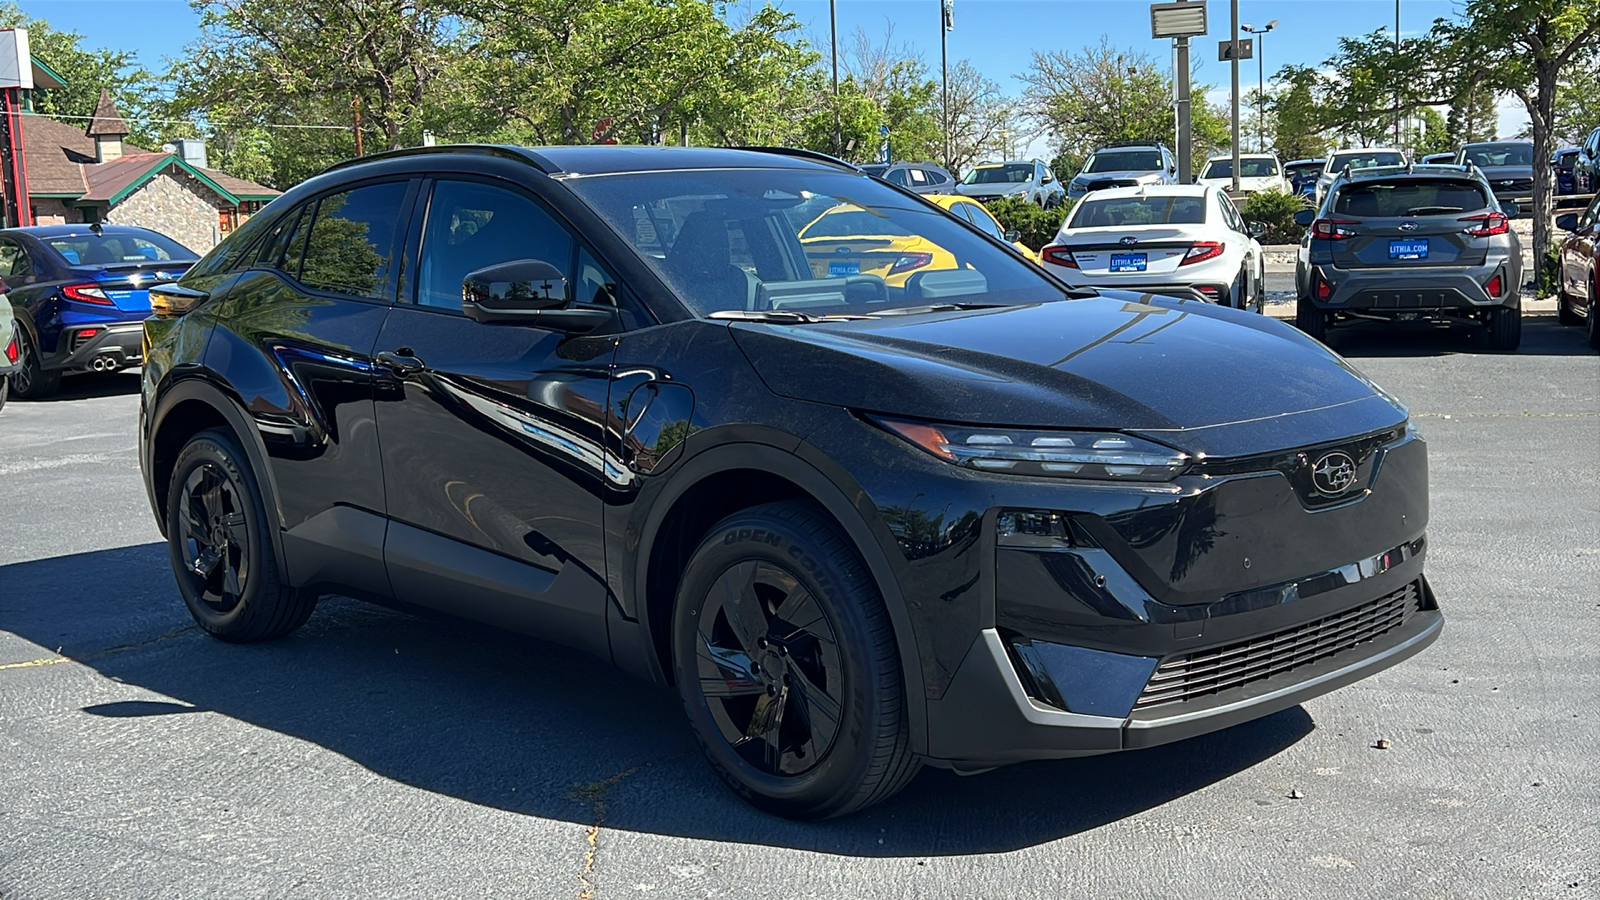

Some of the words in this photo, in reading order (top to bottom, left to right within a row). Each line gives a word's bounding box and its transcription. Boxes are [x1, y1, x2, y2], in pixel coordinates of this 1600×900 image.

[1390, 244, 1428, 253] LITHIA.COM
[1112, 259, 1146, 267] LITHIA.COM
[829, 266, 860, 274] LITHIA.COM
[723, 528, 782, 547] OPEN
